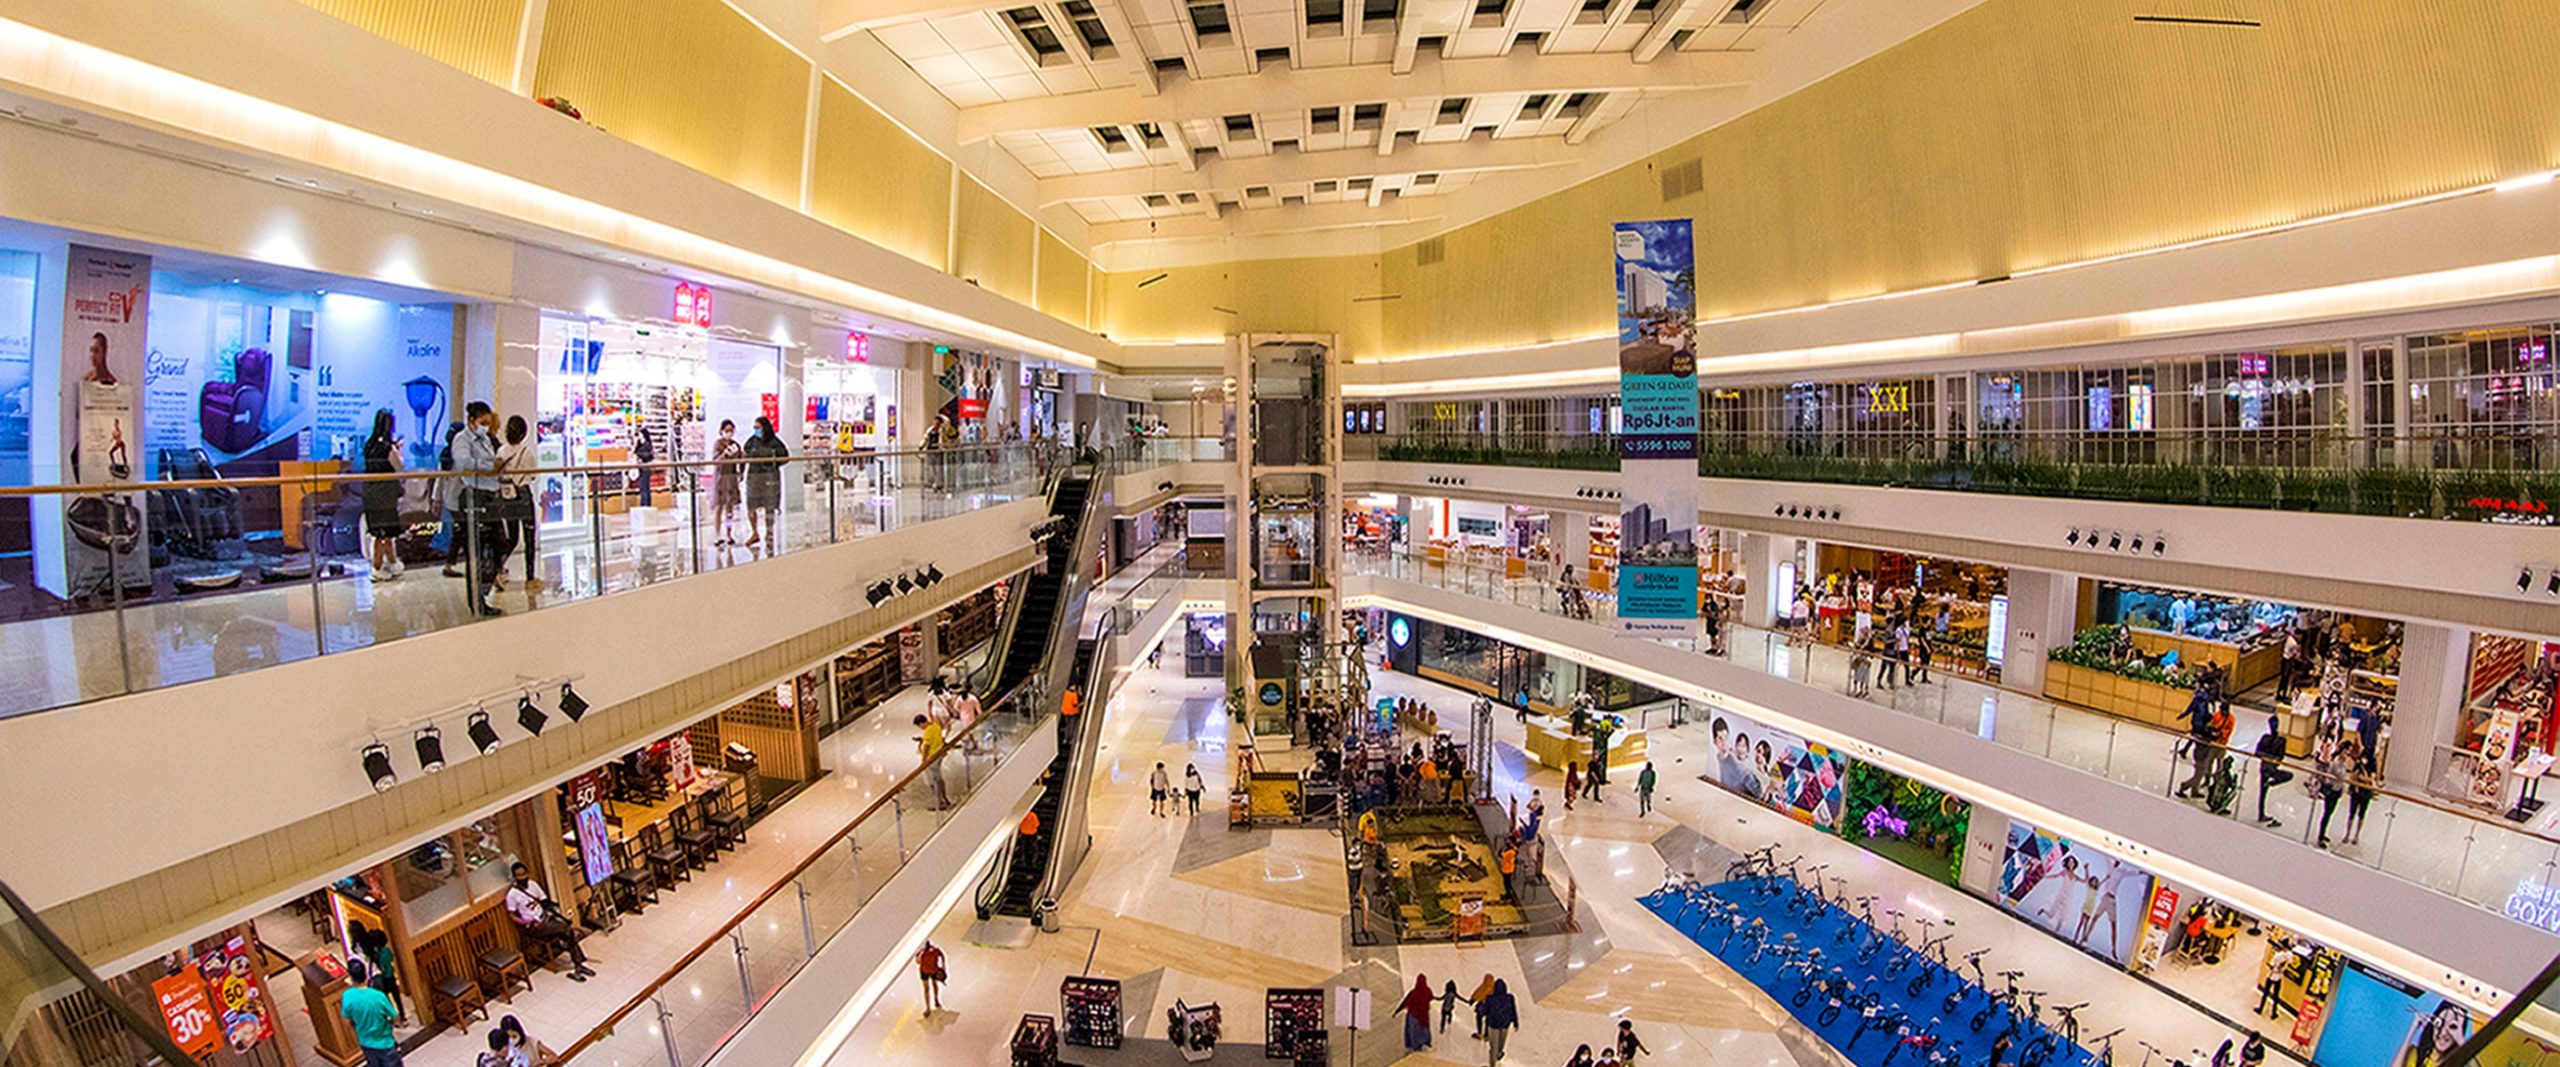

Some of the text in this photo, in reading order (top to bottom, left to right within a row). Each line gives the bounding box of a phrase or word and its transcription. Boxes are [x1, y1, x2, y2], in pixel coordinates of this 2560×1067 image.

[144, 347, 189, 386] Grand
[1623, 382, 1655, 391] GREEN
[1869, 386, 1909, 412] XXI
[1434, 403, 1456, 420] XXI
[1623, 413, 1695, 431] Rp6Jt-an
[1637, 440, 1691, 450] 5596 1000
[1644, 572, 1679, 583] Hilton
[171, 1007, 212, 1044] 30%
